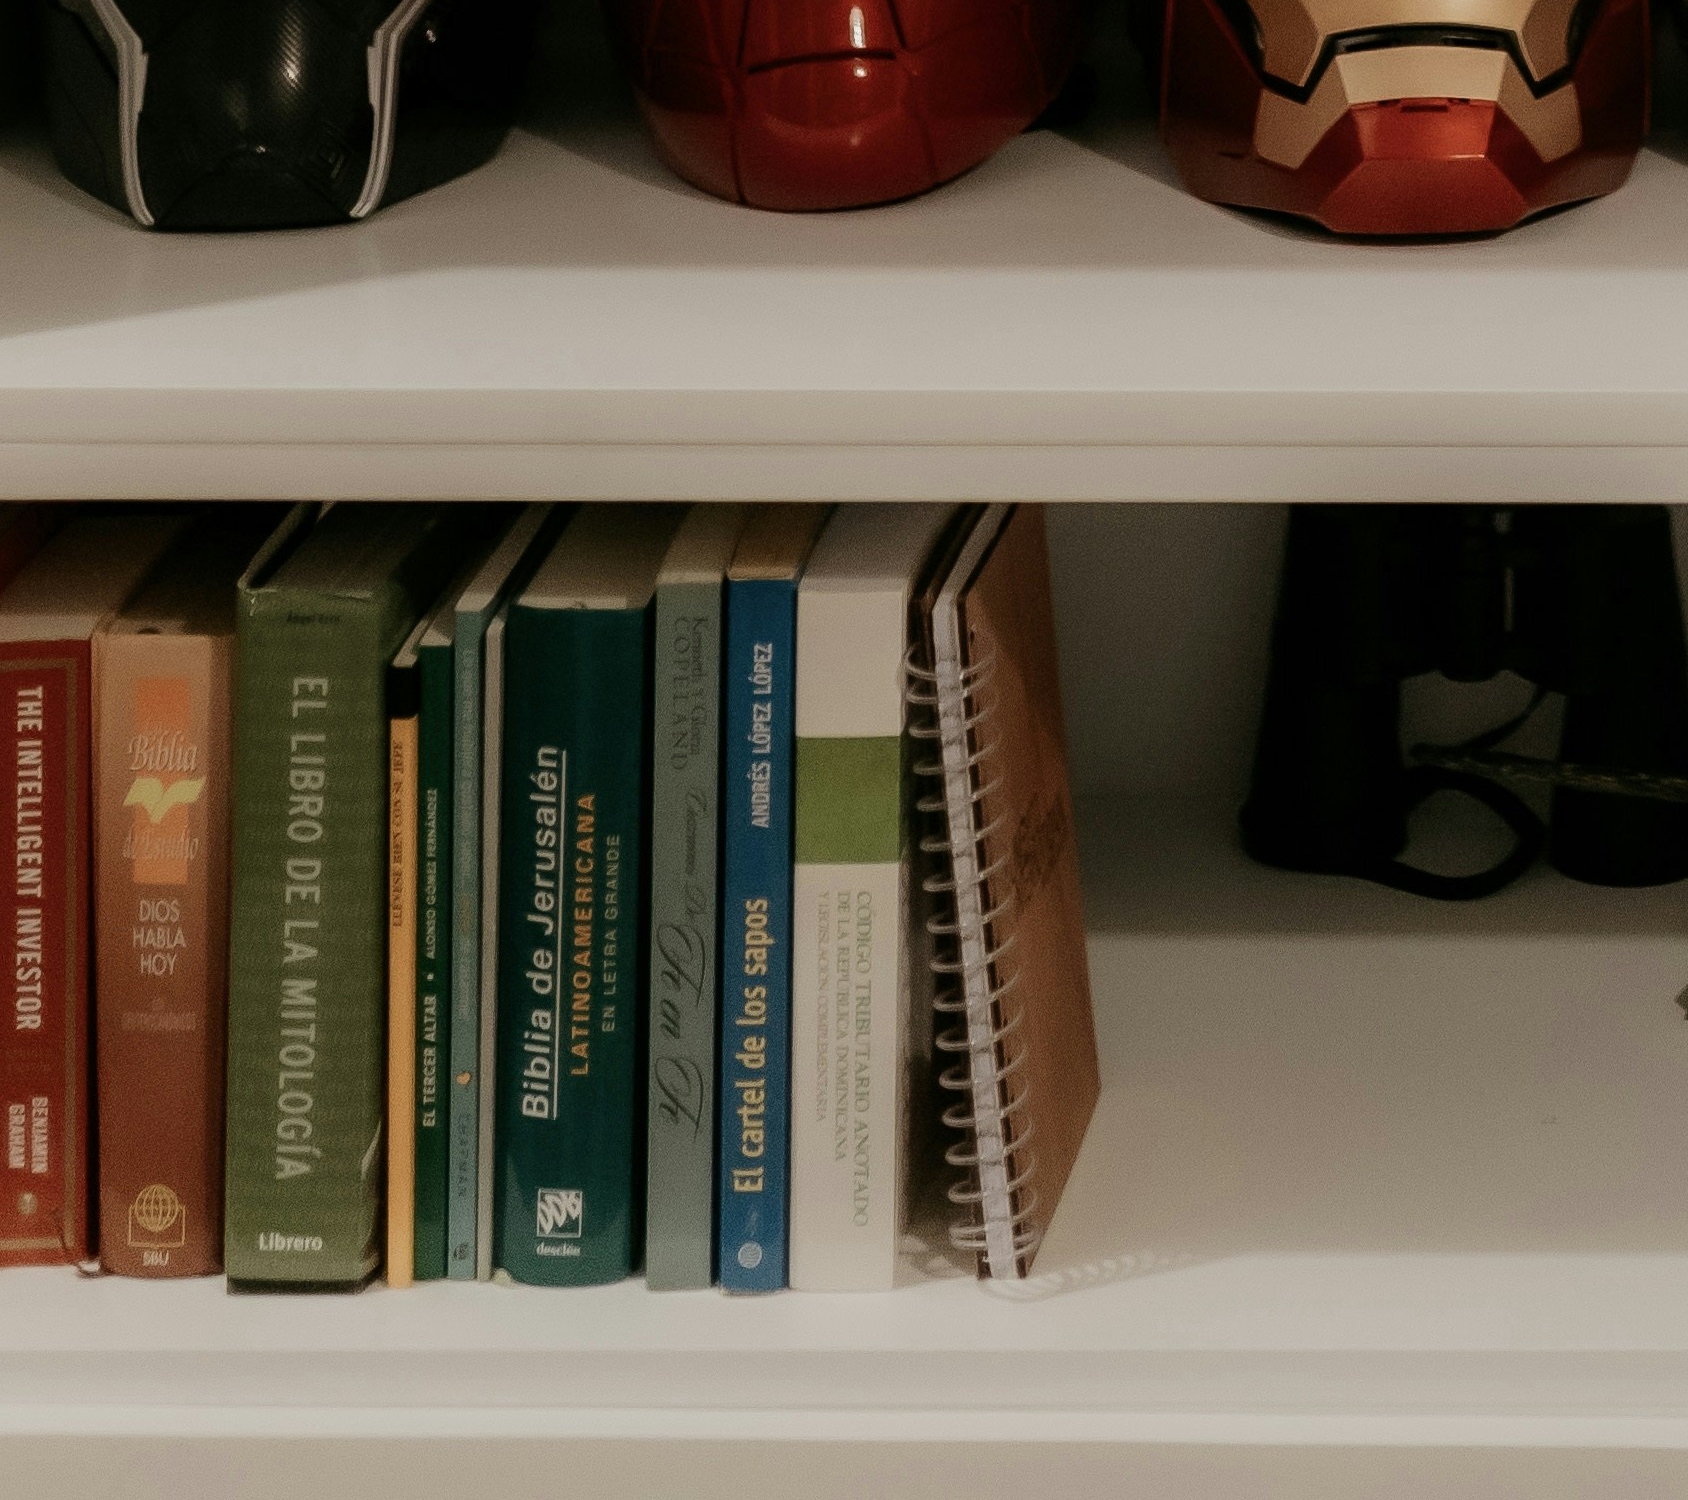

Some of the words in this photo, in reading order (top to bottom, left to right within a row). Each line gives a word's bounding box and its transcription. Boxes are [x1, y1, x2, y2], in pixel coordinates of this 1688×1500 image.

[670, 618, 692, 770] COPELAND
[748, 642, 773, 695] LÓPEZ
[17, 686, 42, 732] THE
[292, 676, 328, 719] EL
[128, 732, 199, 773] Biblia
[747, 702, 772, 754] LÓPEZ
[286, 734, 326, 842] LIBRO
[746, 760, 771, 828] ANDRÉS
[17, 740, 42, 898] INTELLIGENT
[527, 745, 558, 935] Jerusalén
[284, 859, 322, 904] DE
[604, 835, 620, 919] GRANDE
[837, 891, 851, 915] DE
[133, 927, 187, 949] HABLA
[139, 900, 181, 922] DIOS
[425, 908, 438, 960] ALONSO
[571, 793, 595, 1076] LATINOAMERICANA
[744, 898, 775, 976] sapos
[837, 919, 851, 941] LA
[856, 891, 877, 974] CÓDIGO
[16, 908, 42, 1030] INVESTOR
[140, 953, 178, 976] HOY
[282, 920, 319, 965] LA
[603, 929, 617, 995] LETRA
[526, 948, 554, 995] de
[424, 995, 438, 1042] ALTAR
[602, 1005, 616, 1032] EN
[659, 999, 681, 1040] en
[734, 985, 768, 1026] los
[522, 1008, 552, 1119] Biblia
[734, 1035, 767, 1071] de
[854, 982, 872, 1113] TRIBUTARIO
[275, 979, 323, 1181] MITOLOGÍA
[423, 1047, 437, 1106] TERCER
[834, 1045, 850, 1161] DOMINICANA
[8, 1103, 26, 1169] GRAHAM
[31, 1097, 49, 1174] BENJAMIN
[422, 1108, 437, 1127] EL
[734, 1079, 766, 1158] cartel
[458, 1114, 471, 1197] CHAPMAN
[733, 1166, 764, 1192] El
[853, 1120, 870, 1228] ANOTADO
